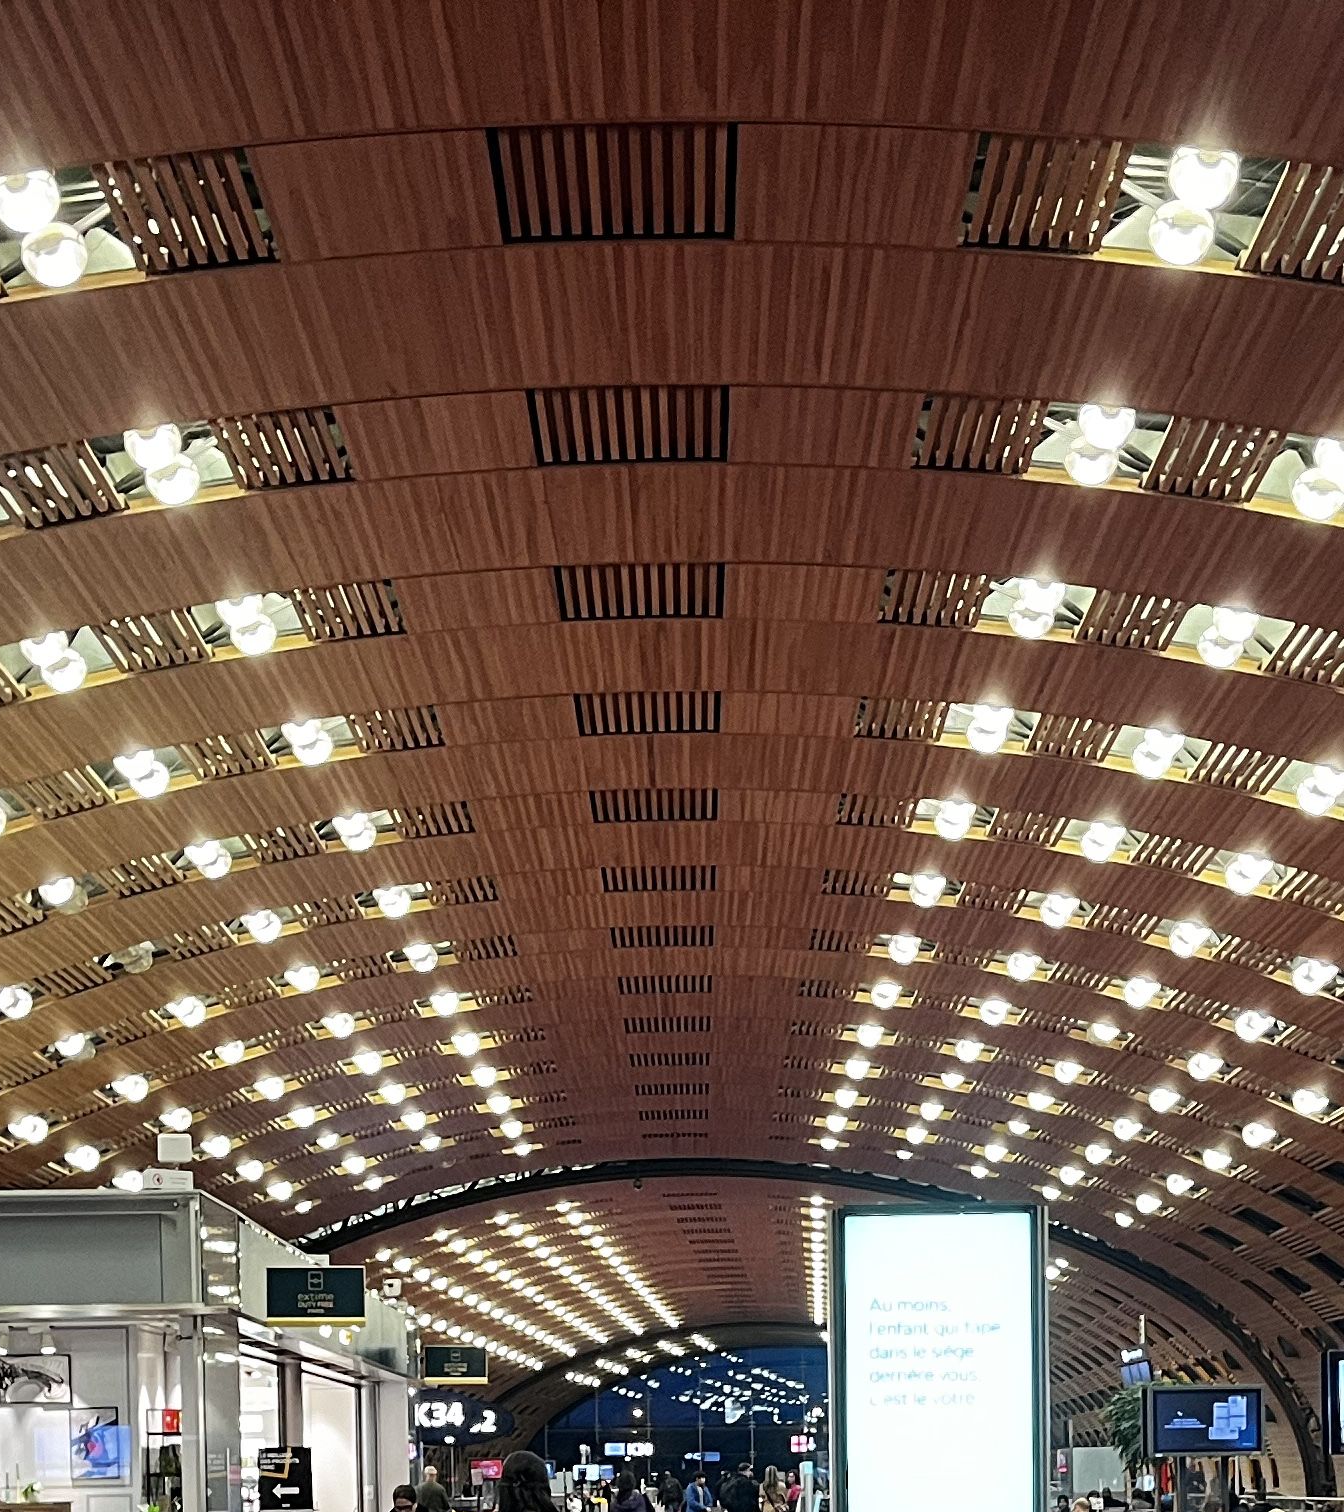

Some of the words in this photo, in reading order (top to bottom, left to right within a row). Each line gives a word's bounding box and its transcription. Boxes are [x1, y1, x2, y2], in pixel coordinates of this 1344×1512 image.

[297, 1293, 334, 1301] extime
[869, 1297, 893, 1312] Au
[869, 1345, 908, 1359] dans
[913, 1345, 927, 1359] le
[415, 1401, 465, 1428] K34
